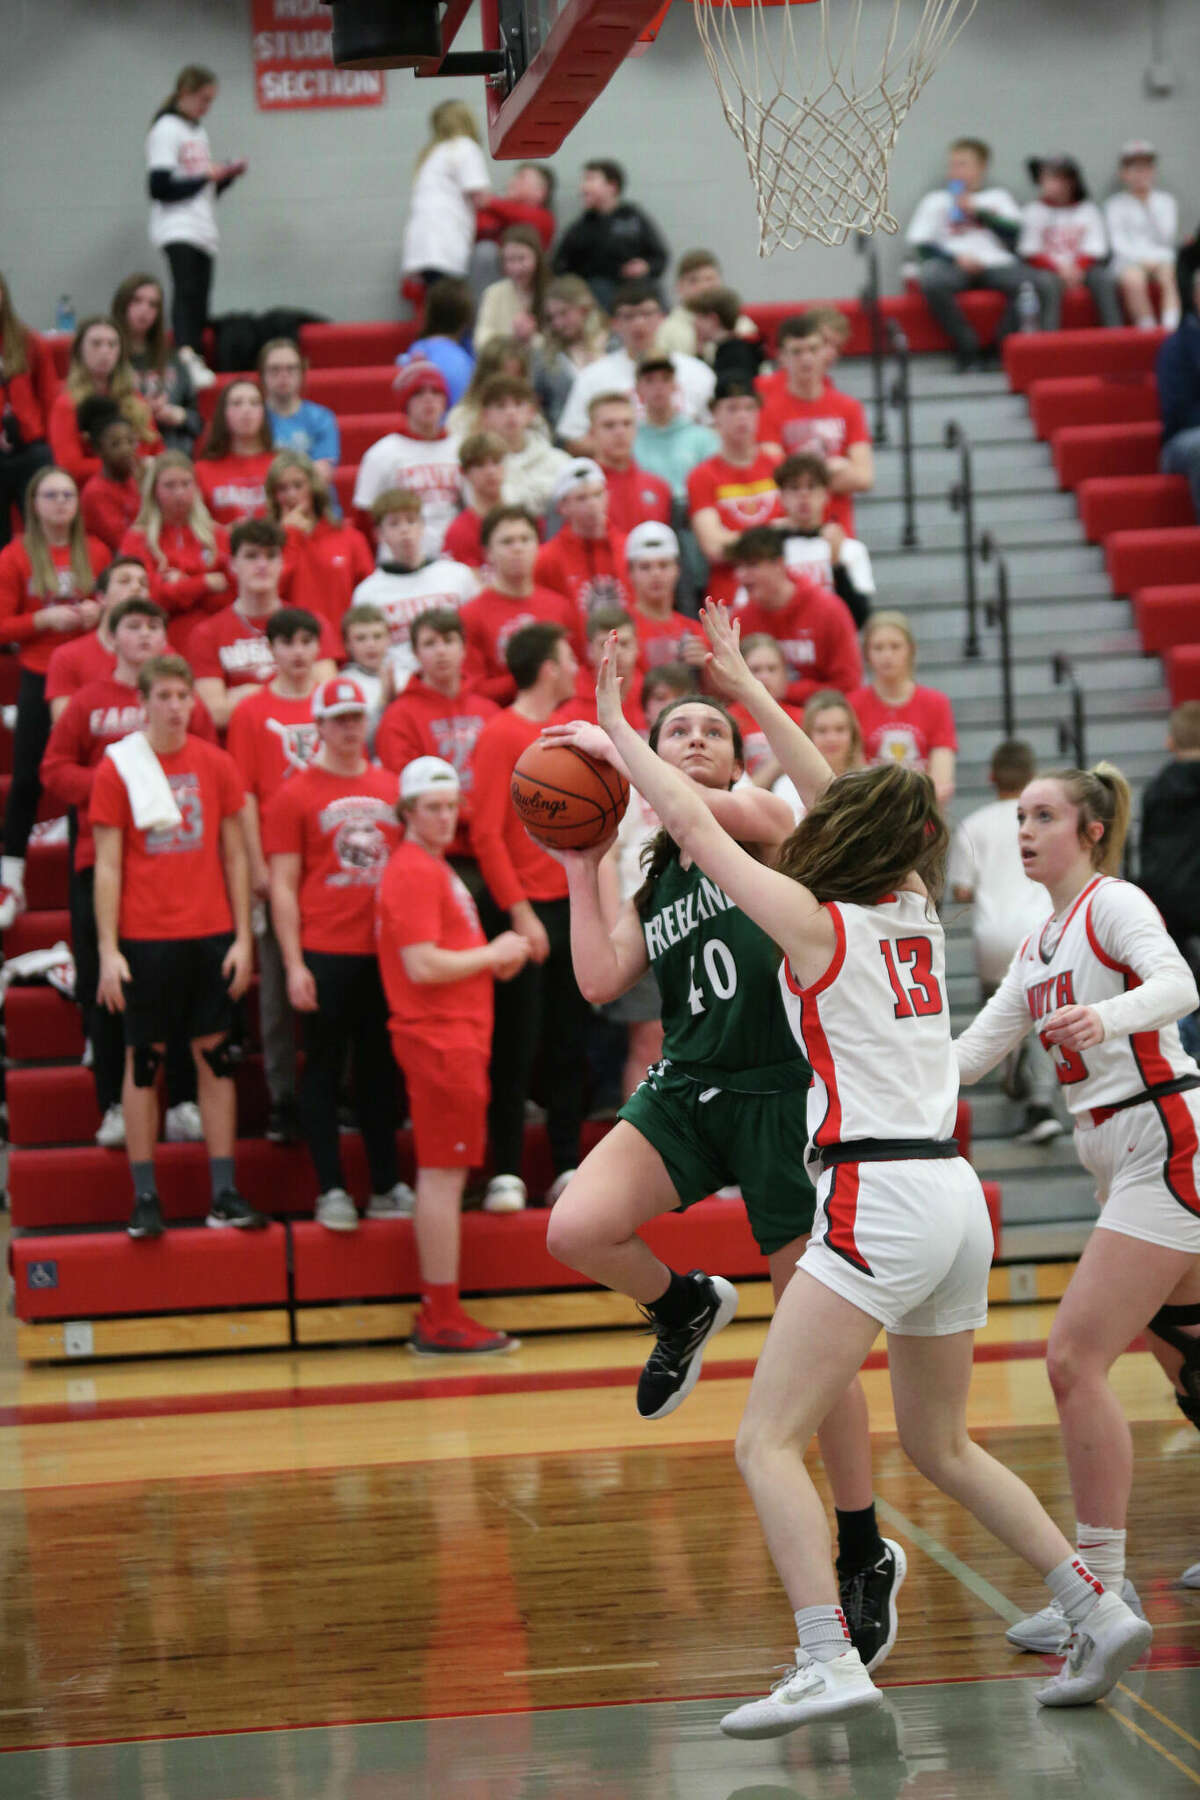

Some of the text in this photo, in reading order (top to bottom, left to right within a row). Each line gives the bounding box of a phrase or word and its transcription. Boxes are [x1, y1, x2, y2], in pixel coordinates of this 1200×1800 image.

[256, 31, 333, 59] STUD
[262, 69, 381, 99] SECTION
[512, 782, 568, 819] Rawlings
[643, 876, 737, 961] FREELAN
[687, 938, 738, 1016] 40
[879, 935, 943, 1019] 13
